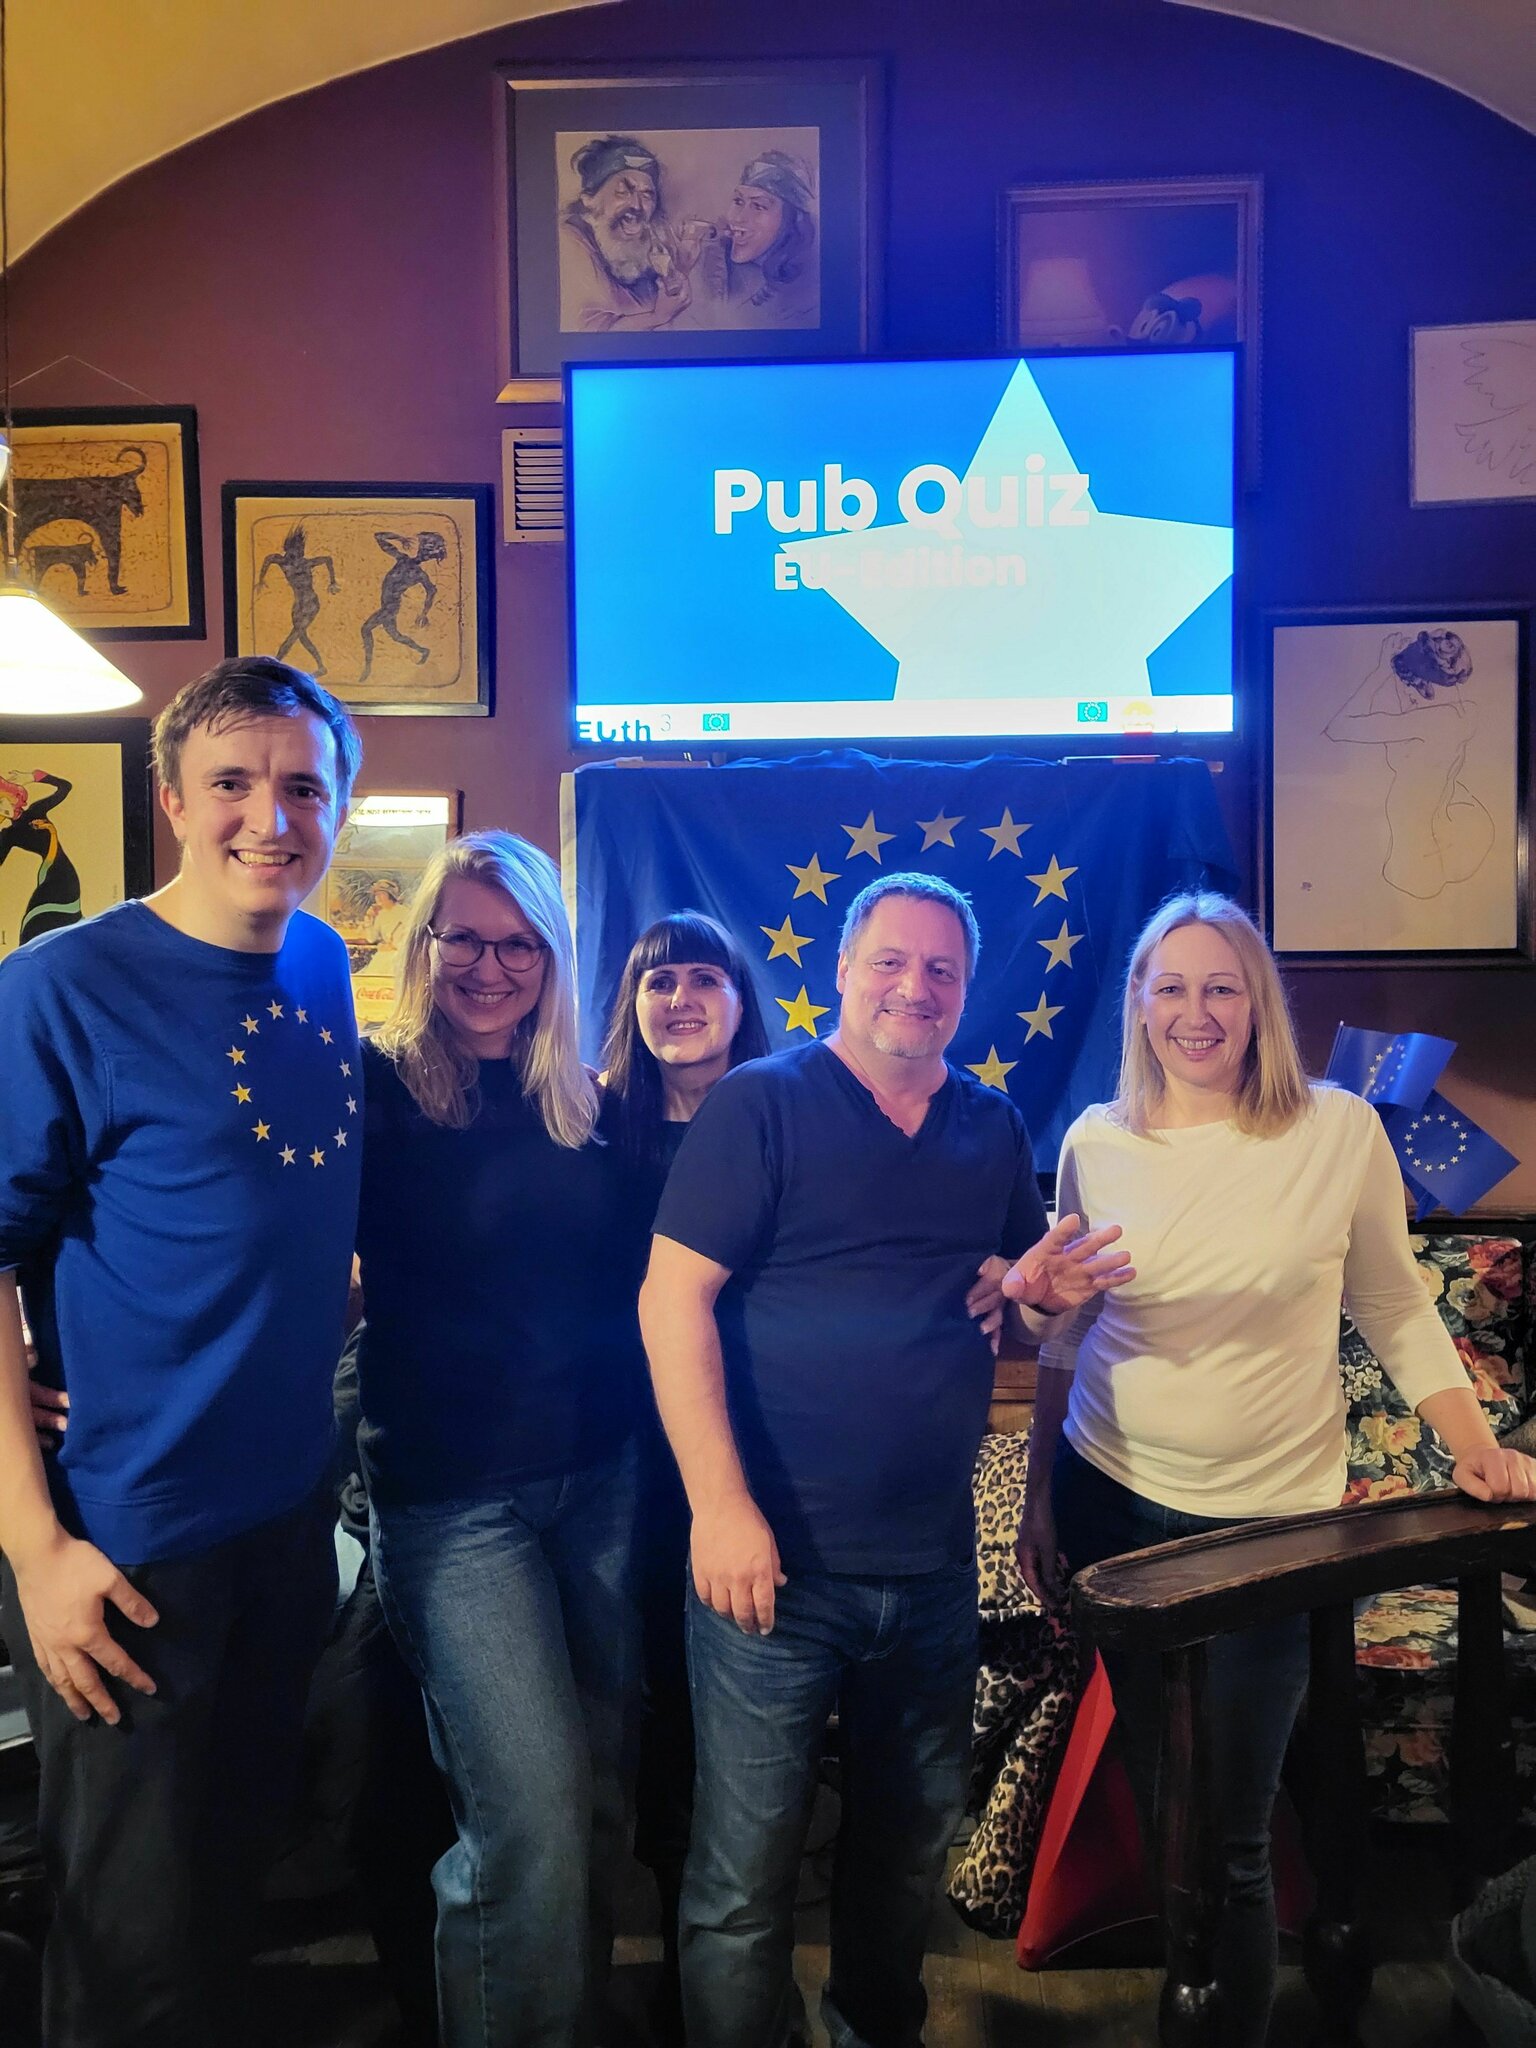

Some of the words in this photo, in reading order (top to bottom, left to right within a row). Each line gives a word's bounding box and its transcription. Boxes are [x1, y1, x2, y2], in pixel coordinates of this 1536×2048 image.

[714, 463, 878, 535] Pub
[897, 453, 1090, 539] Quiz
[774, 545, 1027, 590] EU-Edition
